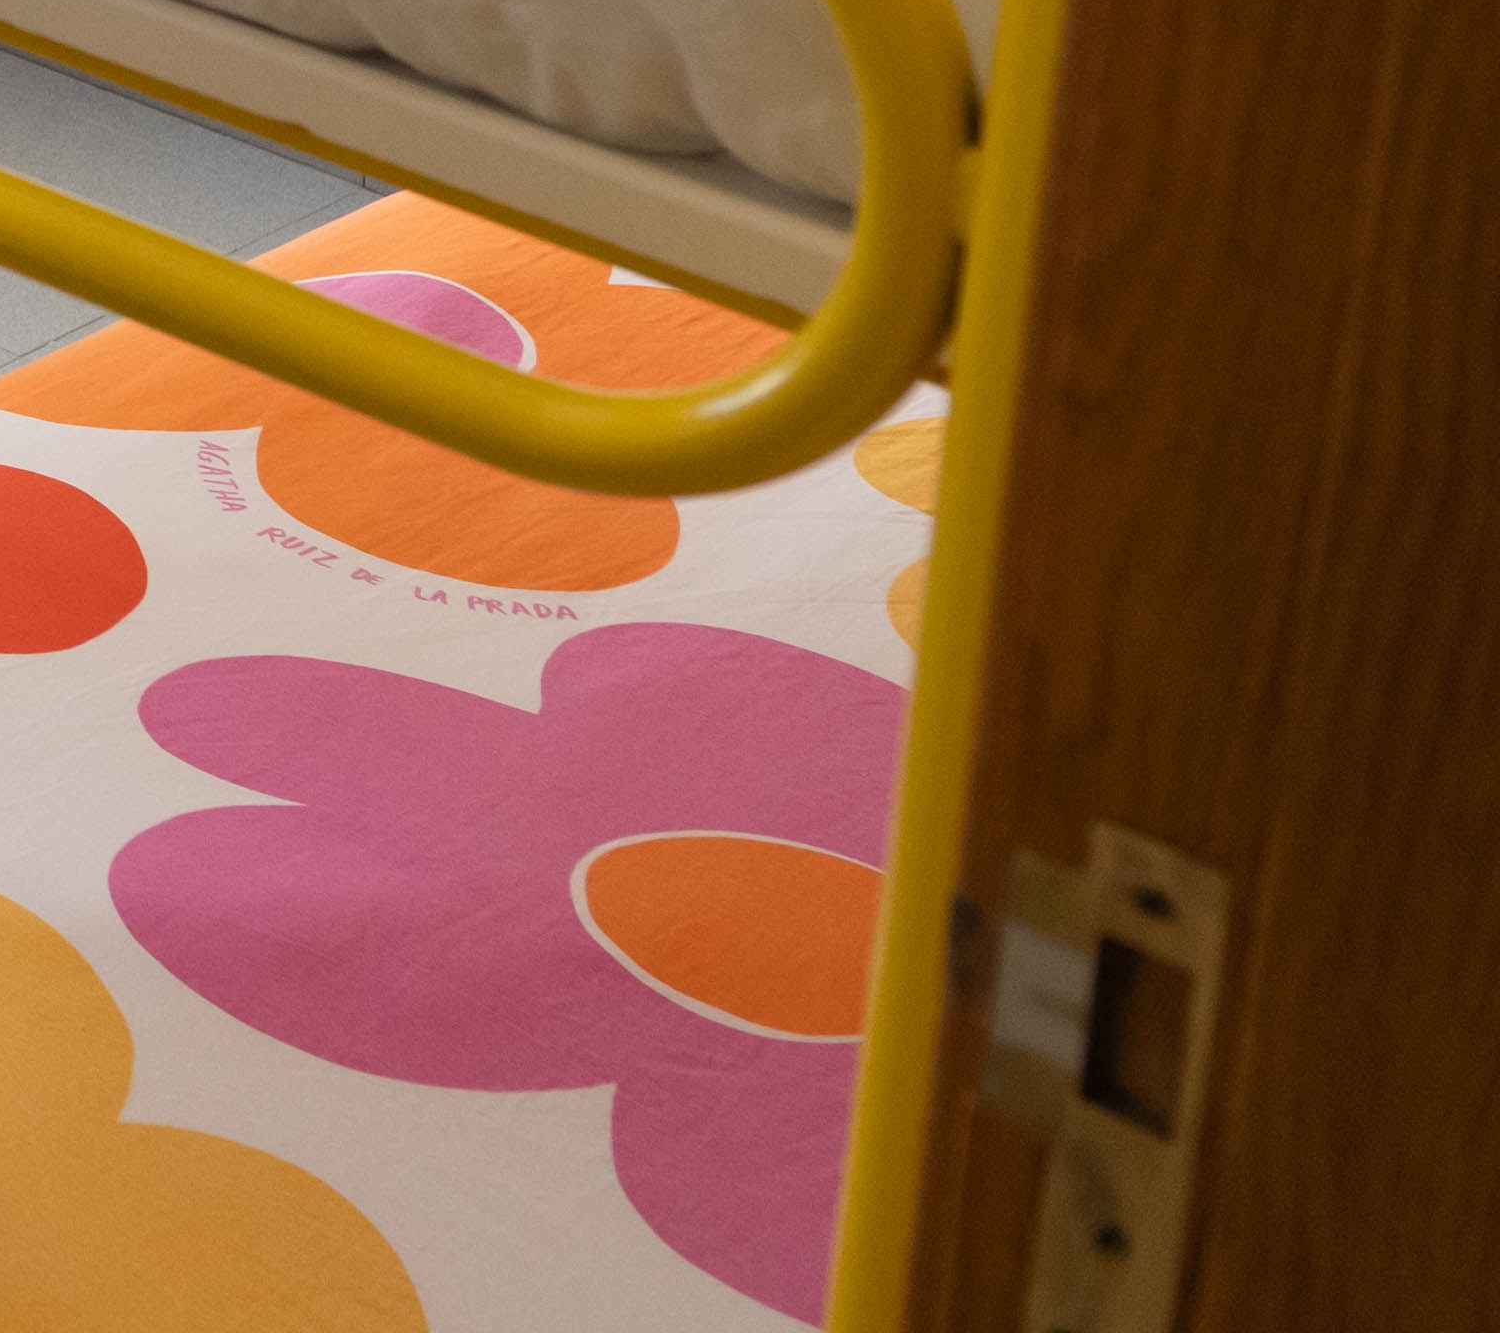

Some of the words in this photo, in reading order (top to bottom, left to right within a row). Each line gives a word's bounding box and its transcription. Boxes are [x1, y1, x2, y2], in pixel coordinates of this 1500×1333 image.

[196, 439, 248, 512] AGATHA
[256, 526, 340, 569] RUIZ
[350, 567, 386, 586] DE
[414, 585, 448, 606] LA
[467, 594, 579, 621] PRADA
